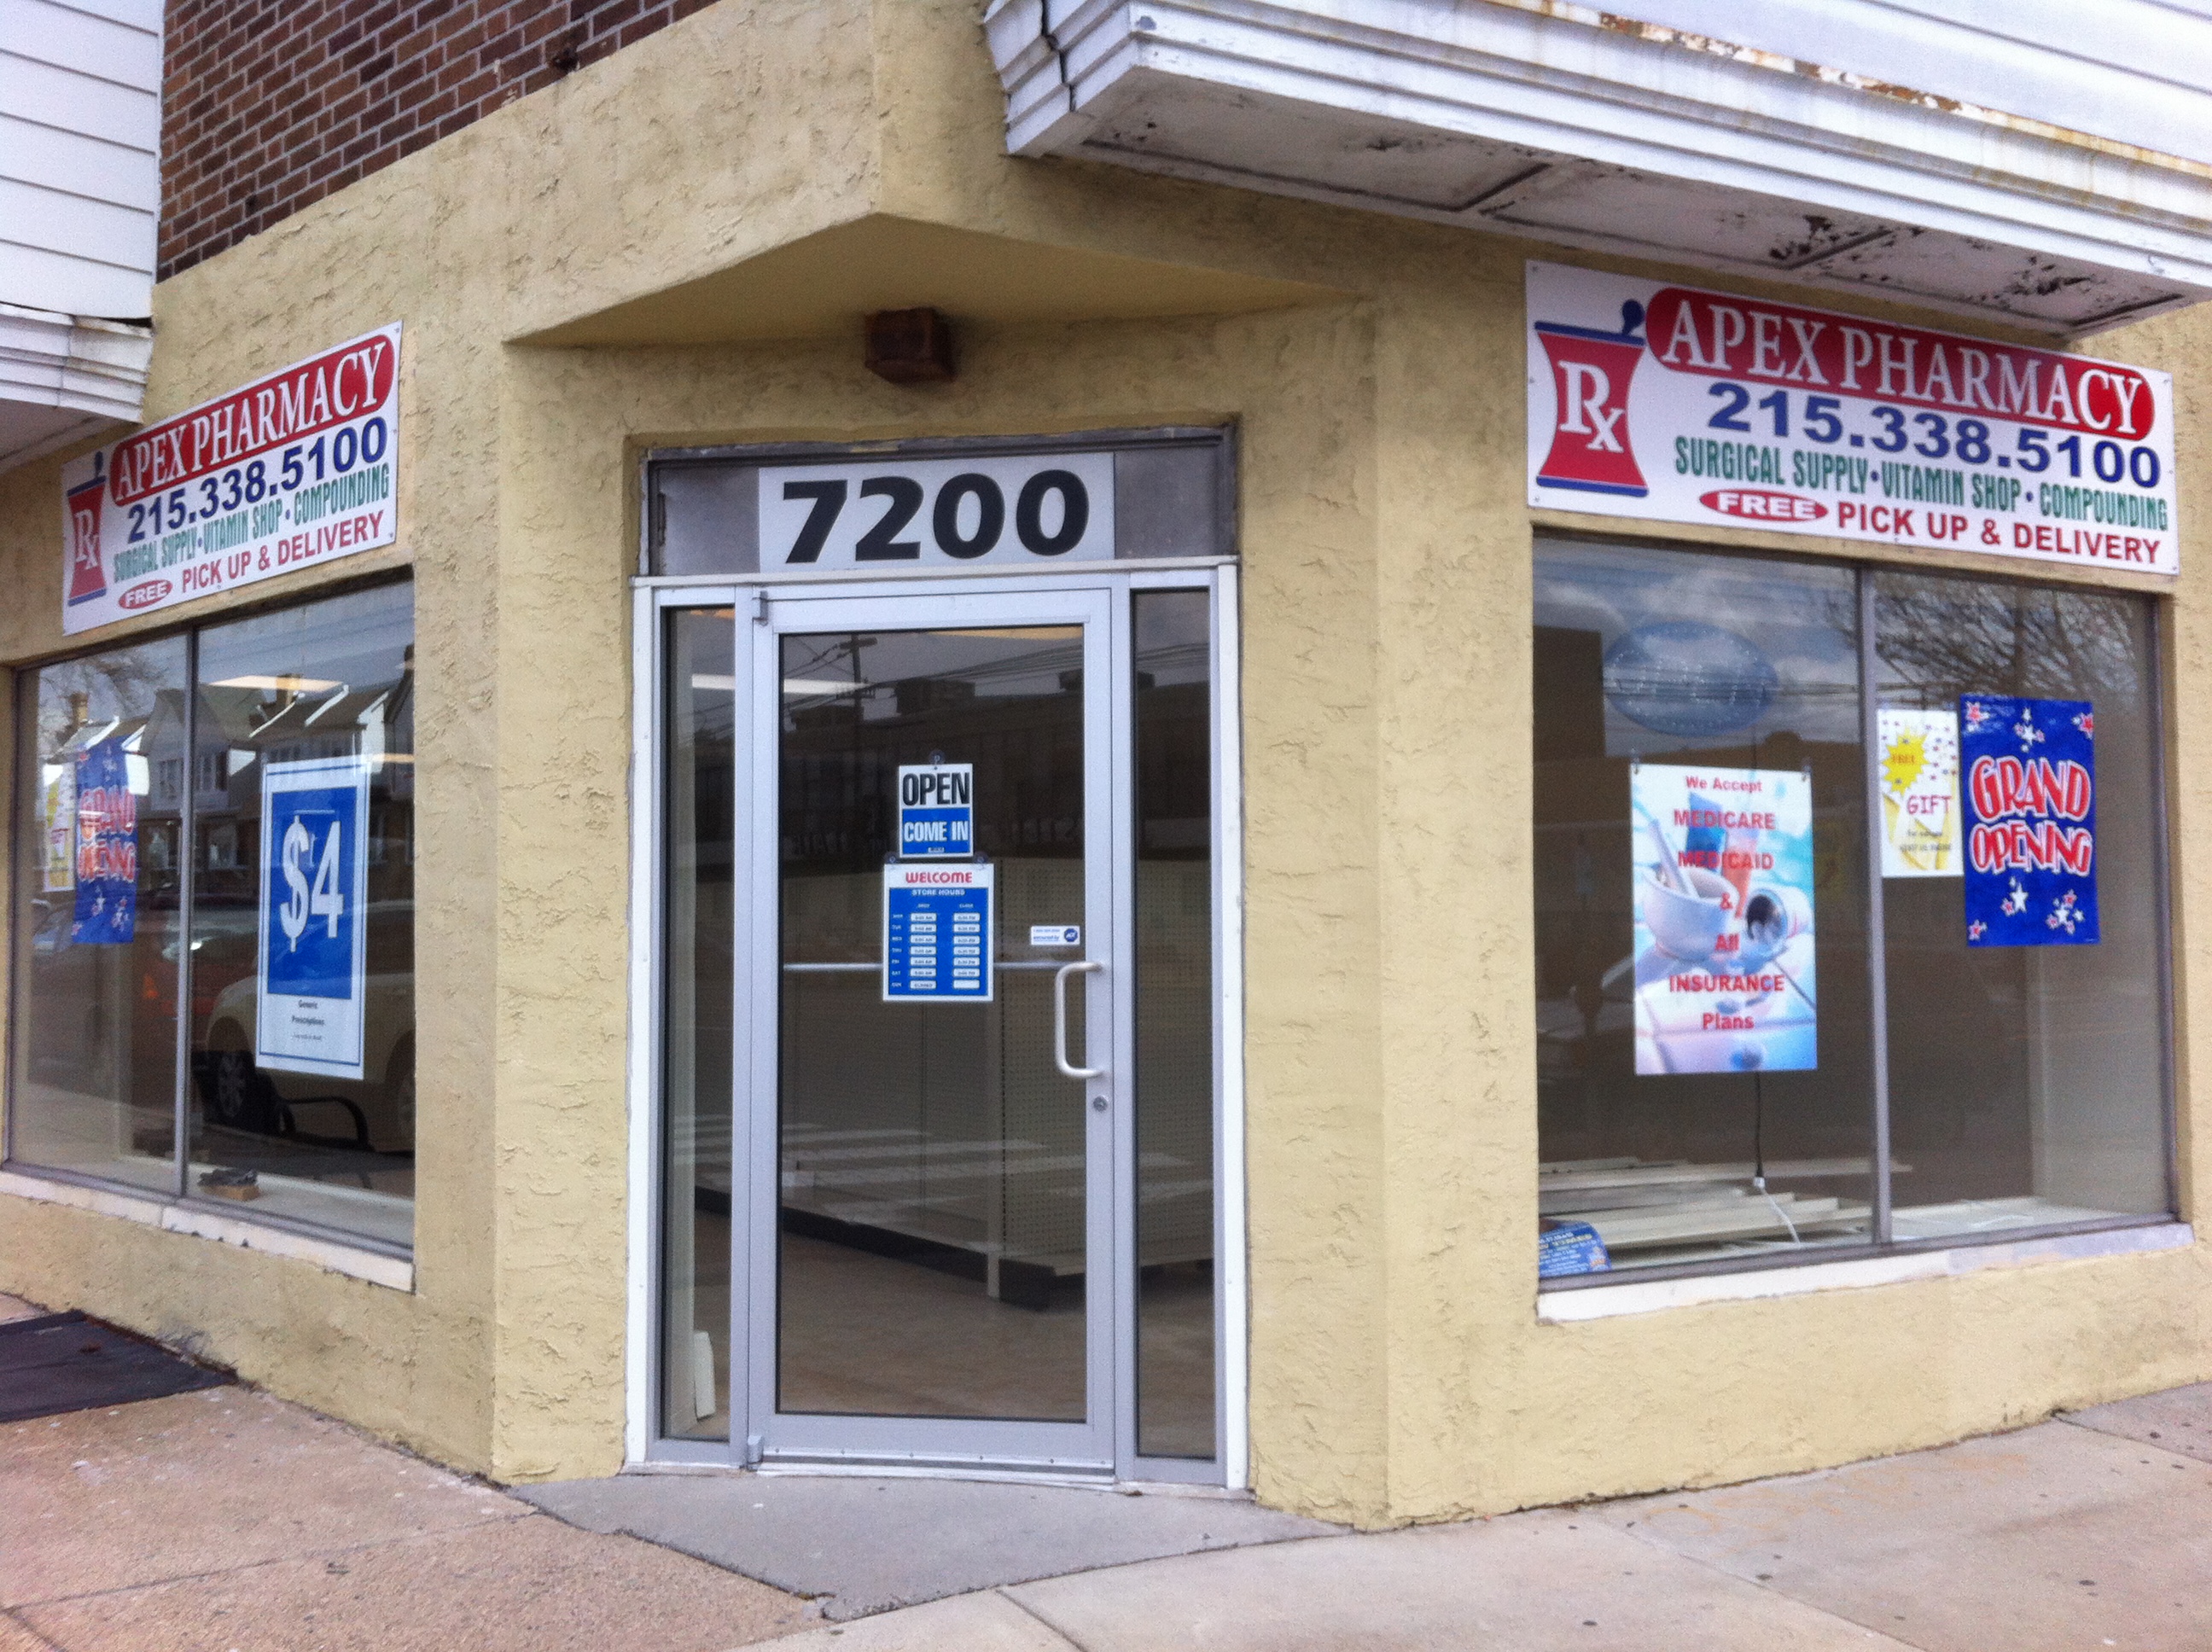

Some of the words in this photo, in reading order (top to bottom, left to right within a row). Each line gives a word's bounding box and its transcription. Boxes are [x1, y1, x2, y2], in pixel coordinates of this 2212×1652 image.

[1662, 300, 1830, 386] APEX
[1839, 325, 2143, 435] PHARMACY
[117, 423, 189, 501] APEX
[191, 341, 386, 473] PHARMACY
[1708, 381, 2161, 489] 215.338.5100
[128, 416, 387, 544] 215.338.5100
[1674, 436, 1785, 486] SURGICAL
[1792, 448, 1869, 494] SUPPLY
[1881, 461, 1965, 507] VITAMIN
[1971, 473, 2021, 513] SHOP
[2040, 482, 2168, 532] COMPOUNDING
[162, 527, 197, 567] SUPPLY
[203, 510, 249, 553] VITAMIN
[253, 498, 282, 539] SHOP
[294, 465, 390, 526] COMPOUNDING
[783, 469, 1090, 564] 7200
[1717, 492, 1819, 519] FREE
[1838, 501, 1914, 536] PICK
[1928, 511, 1968, 540] UP
[1981, 518, 2001, 545] &
[2014, 521, 2161, 564] DELIVERY
[125, 584, 169, 607] FREE
[182, 559, 222, 593] PICK
[228, 551, 252, 579] UP
[259, 544, 271, 571] &
[278, 510, 384, 566] DELIVERY
[902, 772, 969, 806] OPEN
[1685, 776, 1708, 789] We
[1713, 777, 1763, 794] Accept
[1907, 794, 1953, 814] GIFT
[1970, 754, 2091, 822] GRAND
[904, 822, 947, 842] COME
[952, 821, 969, 841] IN
[1674, 809, 1776, 830] MEDICARE
[1970, 819, 2092, 876] OPENING
[279, 815, 344, 953] $4
[905, 871, 973, 884] WELCOME
[1678, 850, 1774, 870] MEDICAID
[1720, 893, 1733, 910] &
[1714, 934, 1739, 952] All
[1669, 974, 1785, 993] INSURANCE
[1702, 1012, 1755, 1030] Plans
